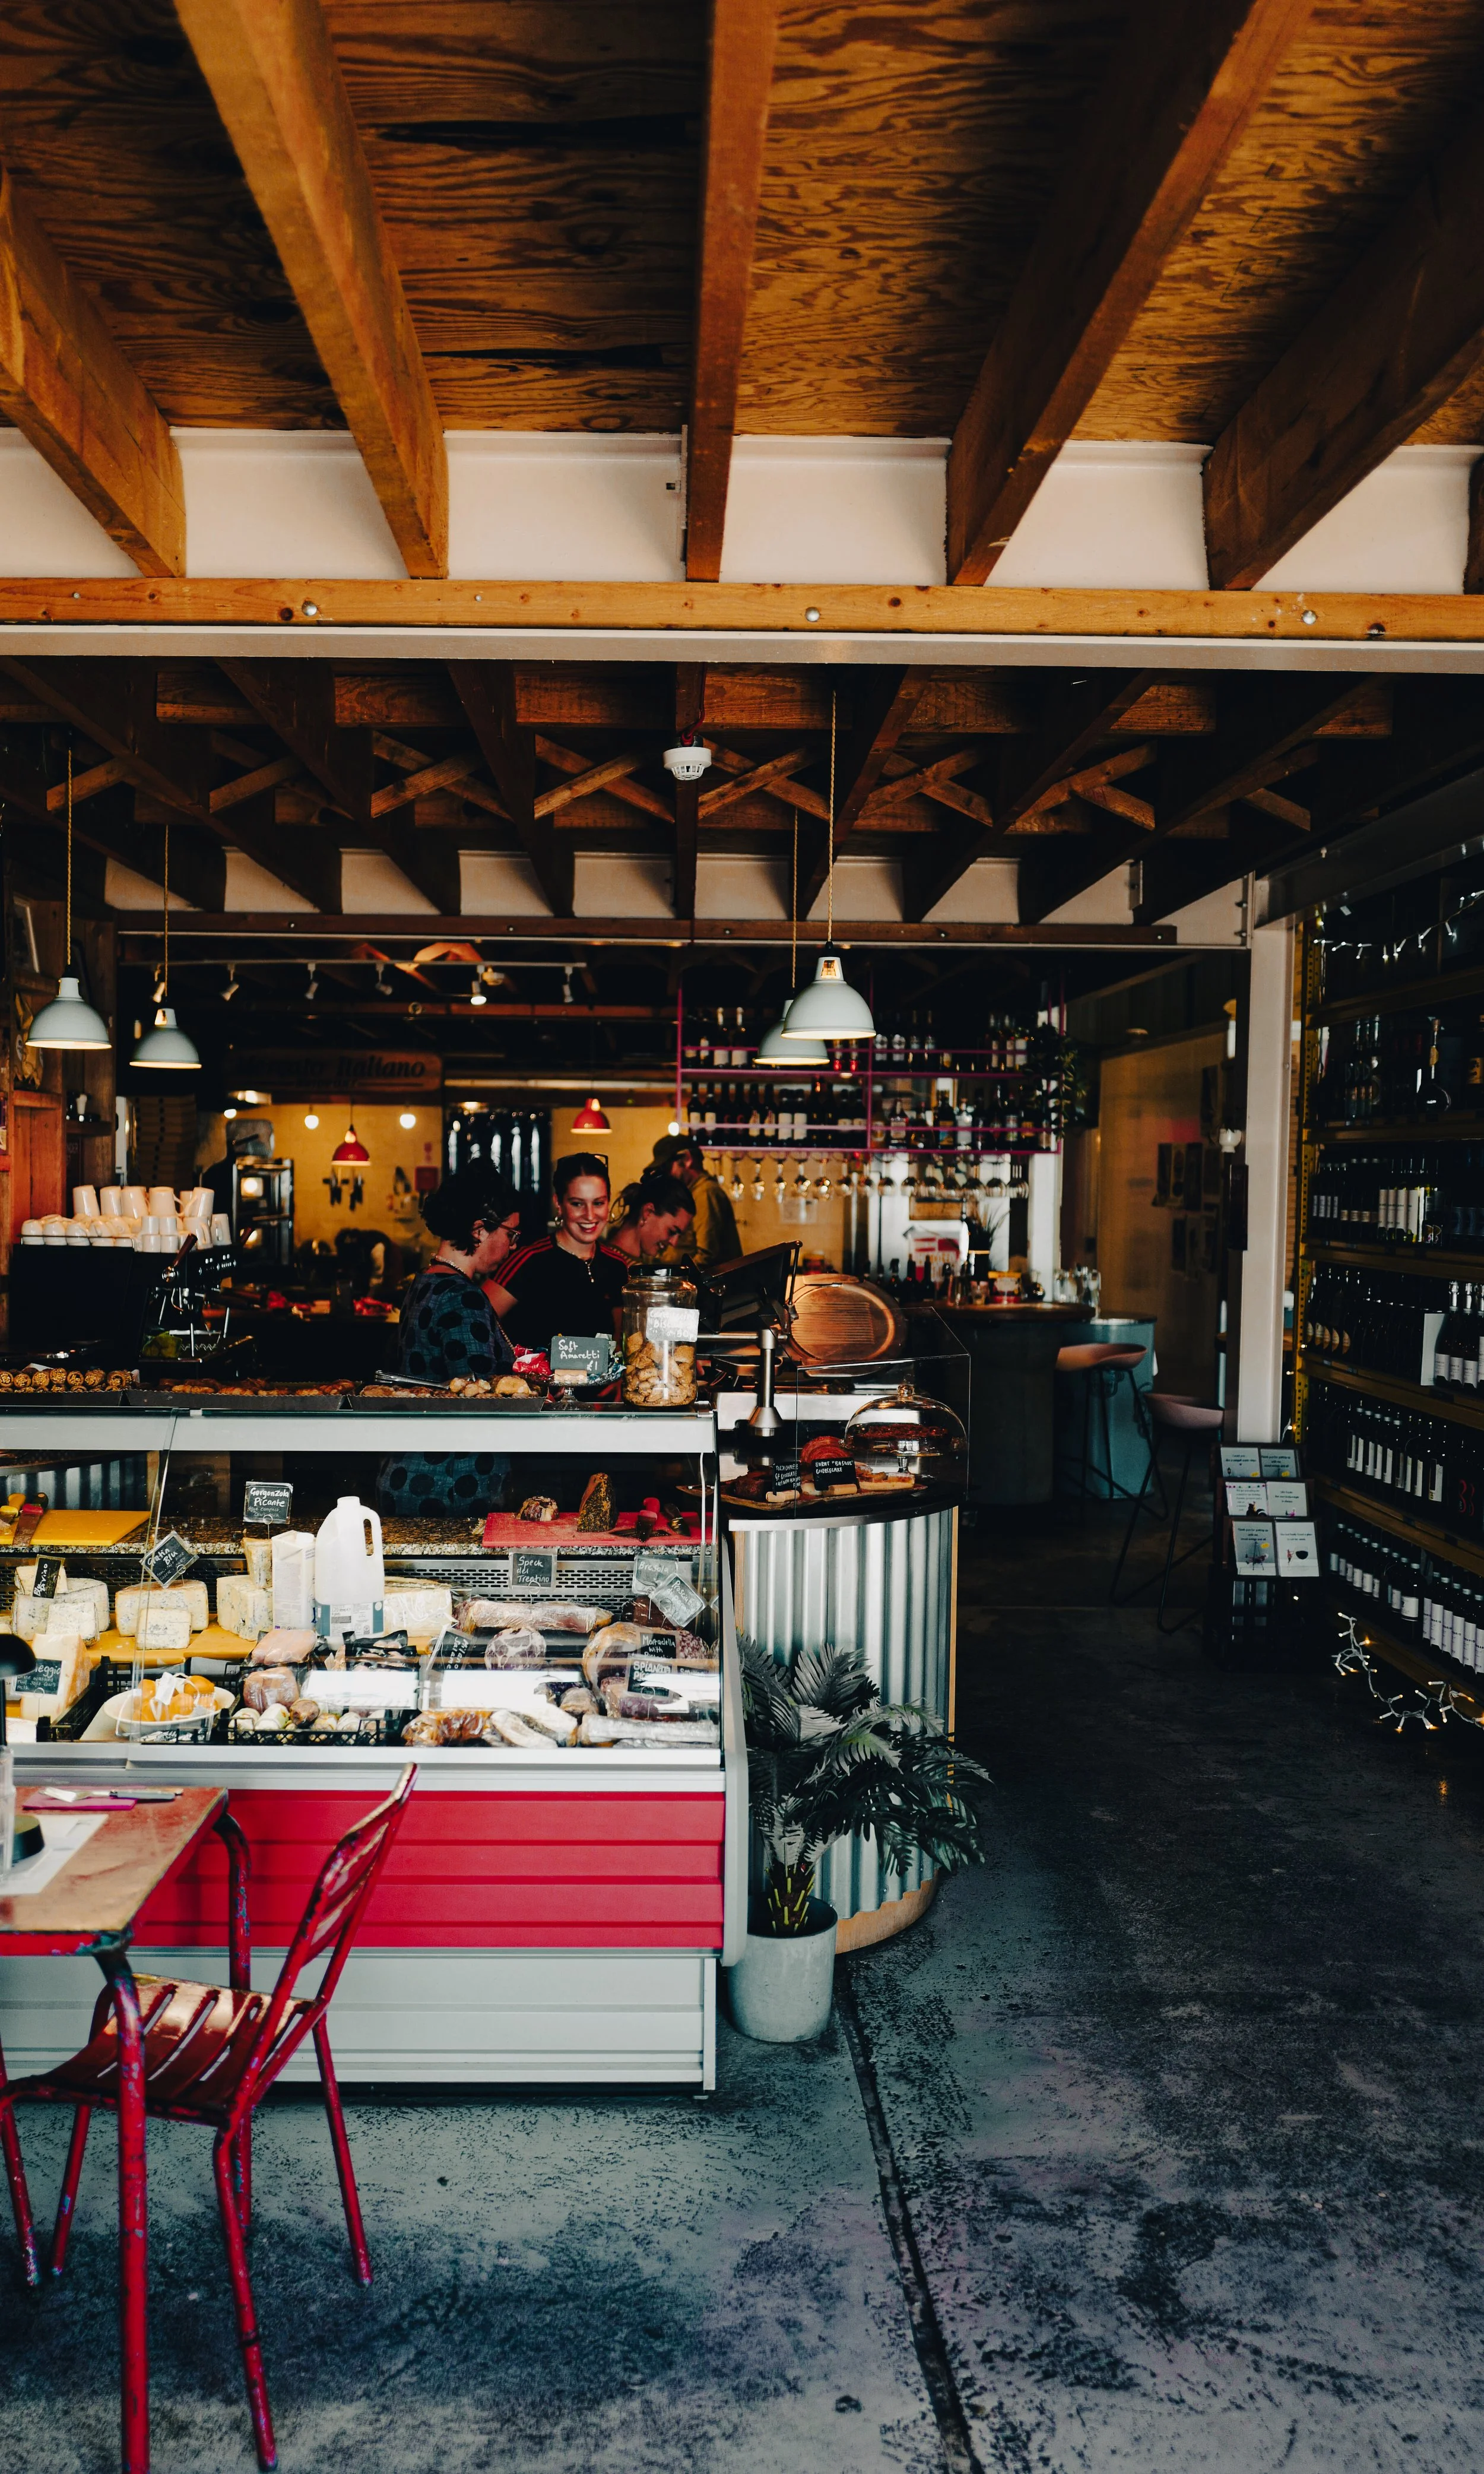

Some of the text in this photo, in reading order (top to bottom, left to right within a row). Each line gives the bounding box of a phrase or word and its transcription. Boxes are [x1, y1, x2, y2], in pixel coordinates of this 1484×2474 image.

[337, 1055, 426, 1078] Italiano
[558, 1339, 578, 1353] Soft
[560, 1350, 600, 1360] Amaretti
[586, 1360, 598, 1371] £1
[253, 1497, 286, 1507] Picante
[518, 1556, 544, 1570] Speck
[517, 1574, 550, 1583] Trentino
[36, 1662, 61, 1678] leggio
